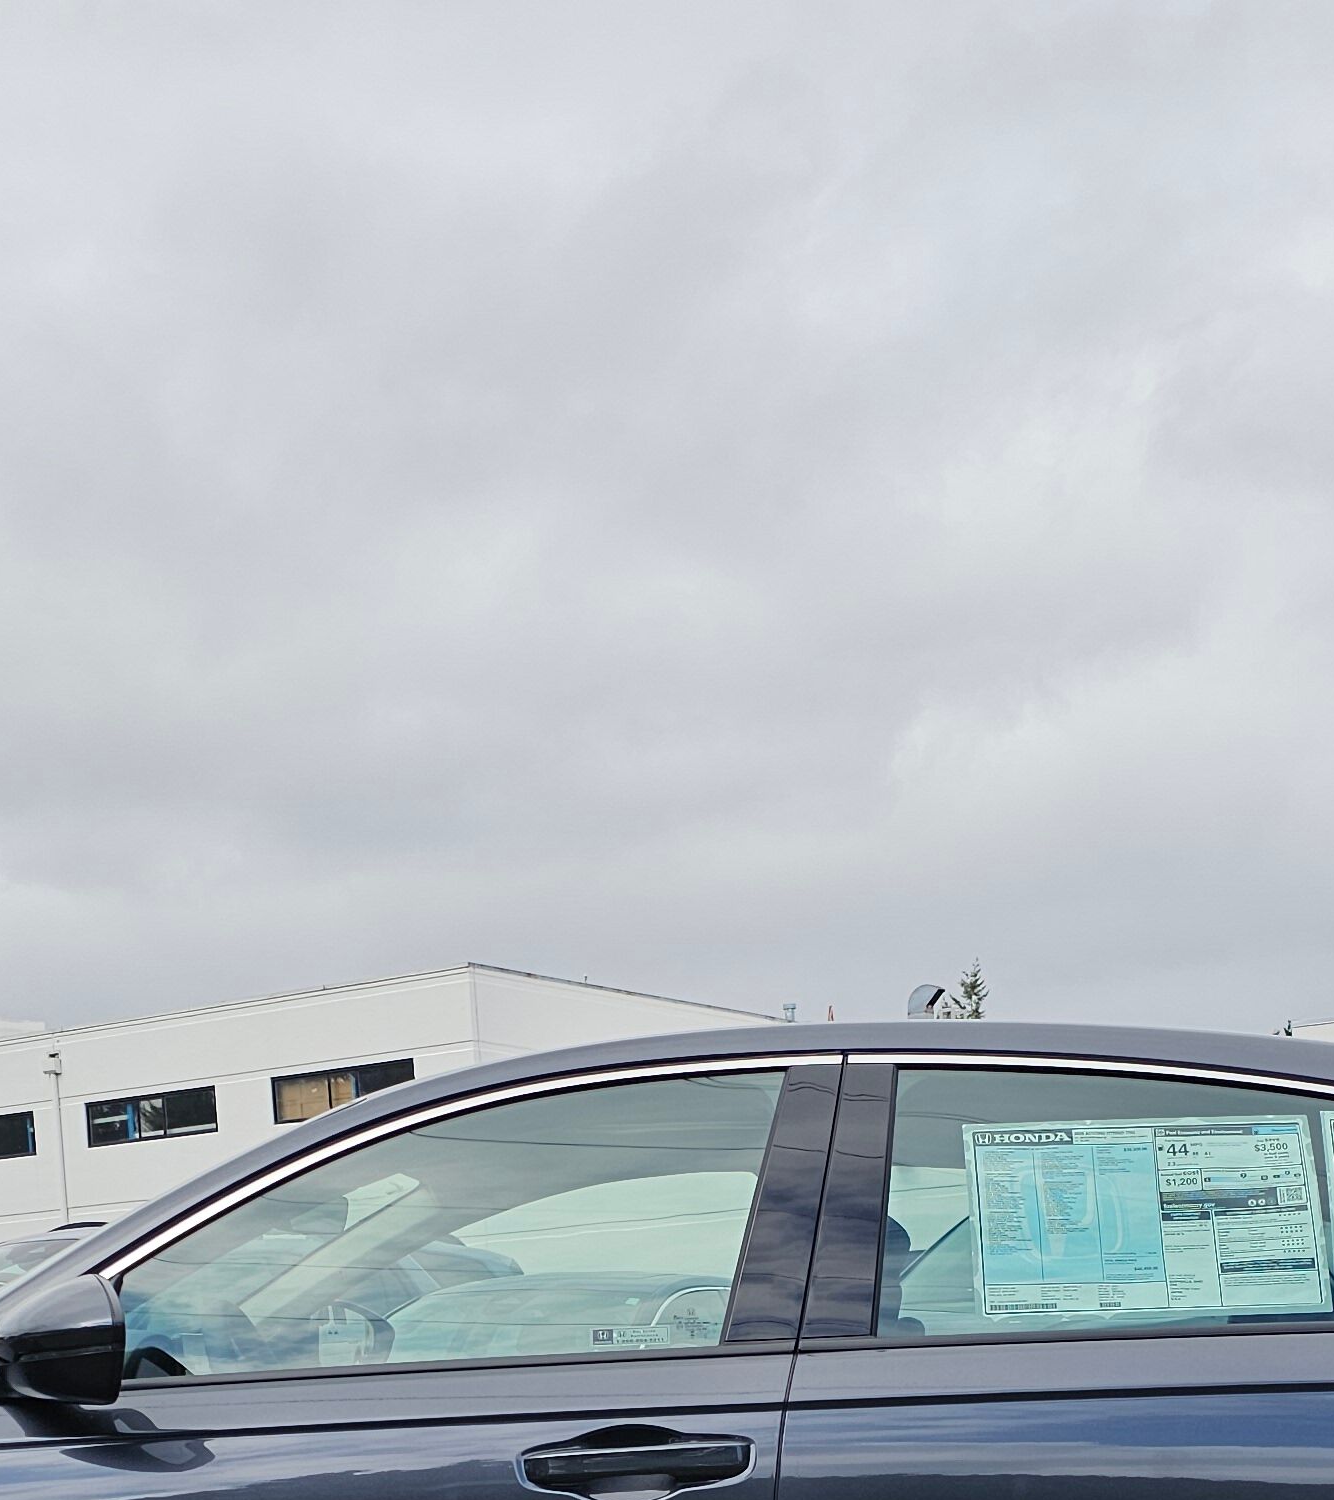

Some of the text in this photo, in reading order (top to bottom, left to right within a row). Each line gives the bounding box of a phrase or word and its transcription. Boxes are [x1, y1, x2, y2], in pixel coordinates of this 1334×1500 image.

[994, 1132, 1071, 1144] HONDA
[1167, 1143, 1189, 1156] 44
[1254, 1142, 1288, 1153] $3,500
[1165, 1177, 1198, 1187] $1,200
